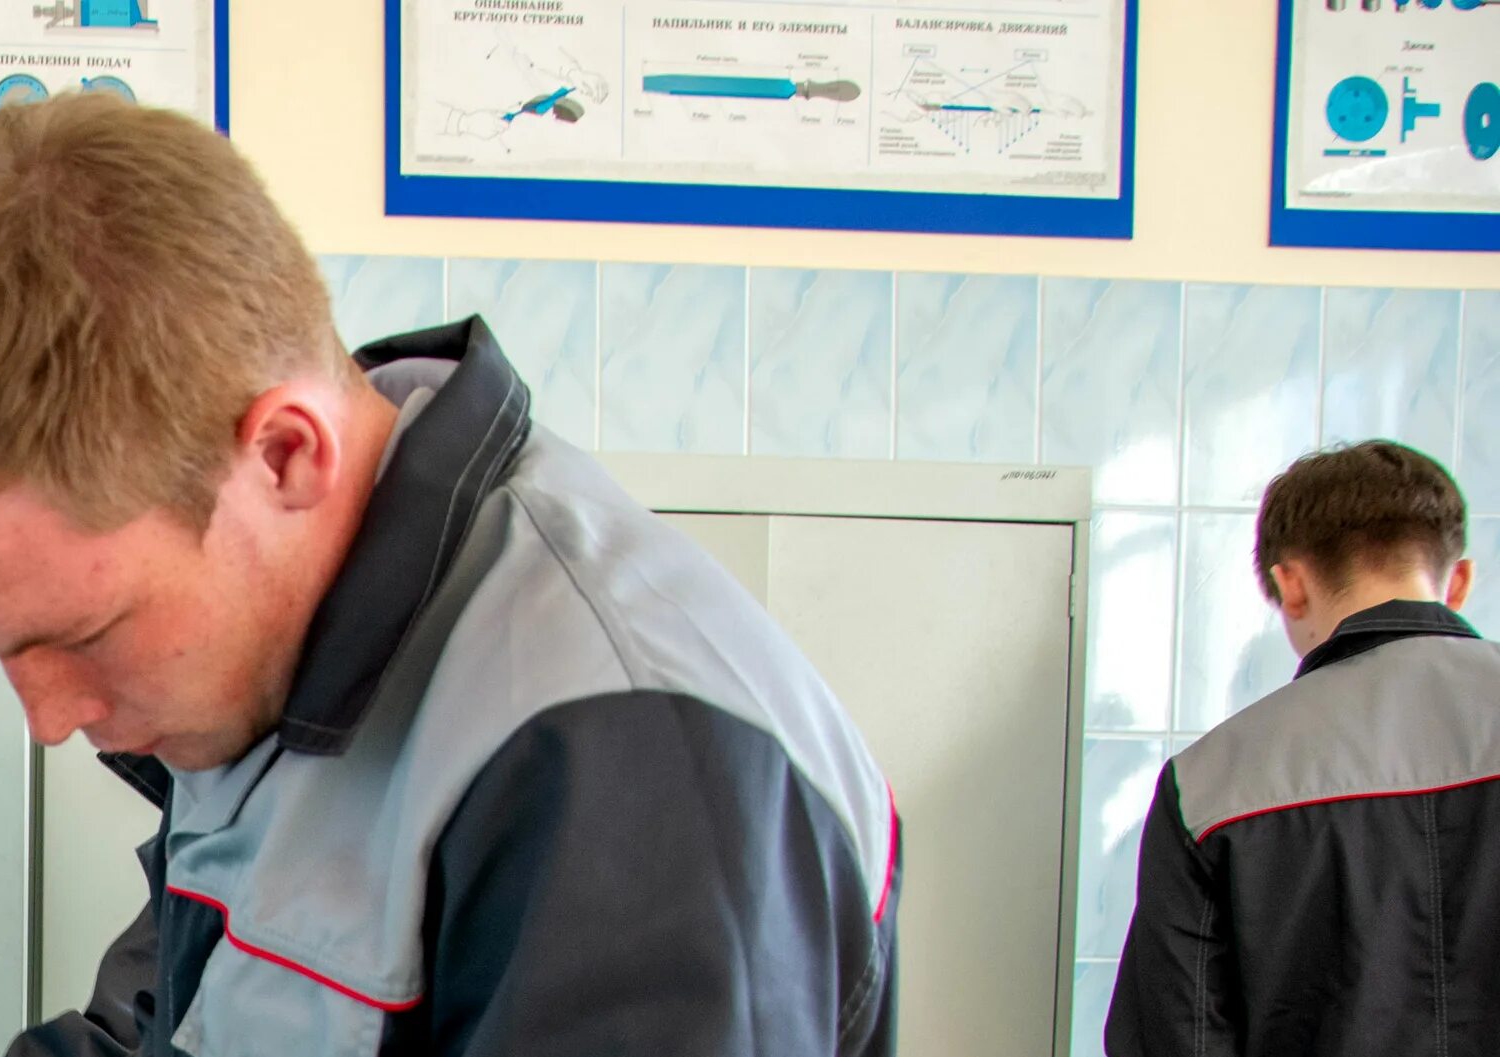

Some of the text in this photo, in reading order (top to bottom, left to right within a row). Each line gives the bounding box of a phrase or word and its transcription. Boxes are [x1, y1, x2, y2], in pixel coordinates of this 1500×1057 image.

[454, 11, 583, 25] КРУГЛОГО СТЕРЖНЯ
[652, 18, 848, 35] НАПИЛЬНИК И ЕГО ЭЛЕМЕНТЫ
[895, 18, 1068, 36] БАЛАНСИРОВКА ДВИЖЕНИЙ
[87, 56, 132, 69] ПОДАЧ
